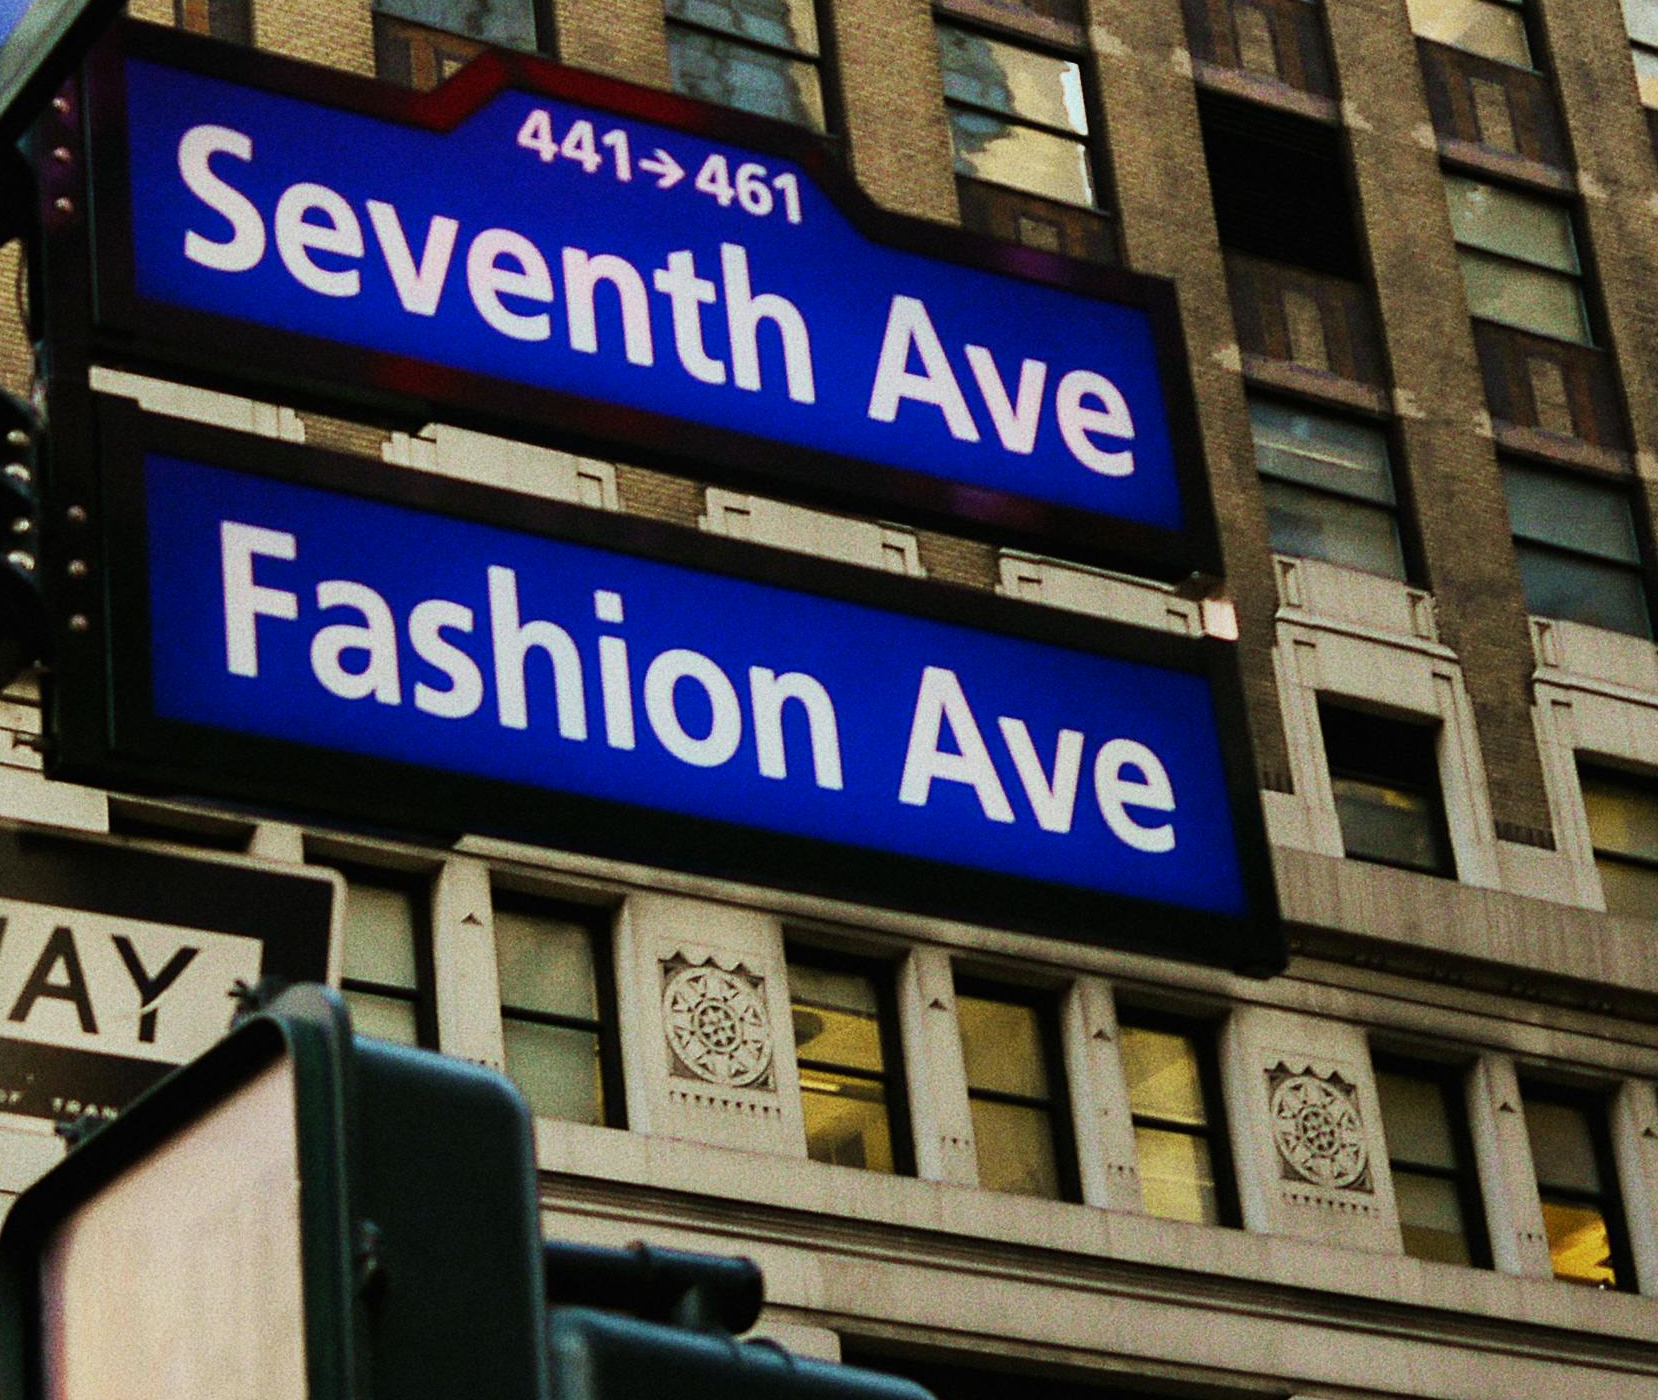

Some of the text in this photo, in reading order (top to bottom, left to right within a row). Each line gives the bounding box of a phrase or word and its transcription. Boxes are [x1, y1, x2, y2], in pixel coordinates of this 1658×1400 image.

[178, 124, 1135, 477] Seventh Ave
[516, 108, 802, 224] 441 461
[220, 520, 1176, 853] Fashion Ave
